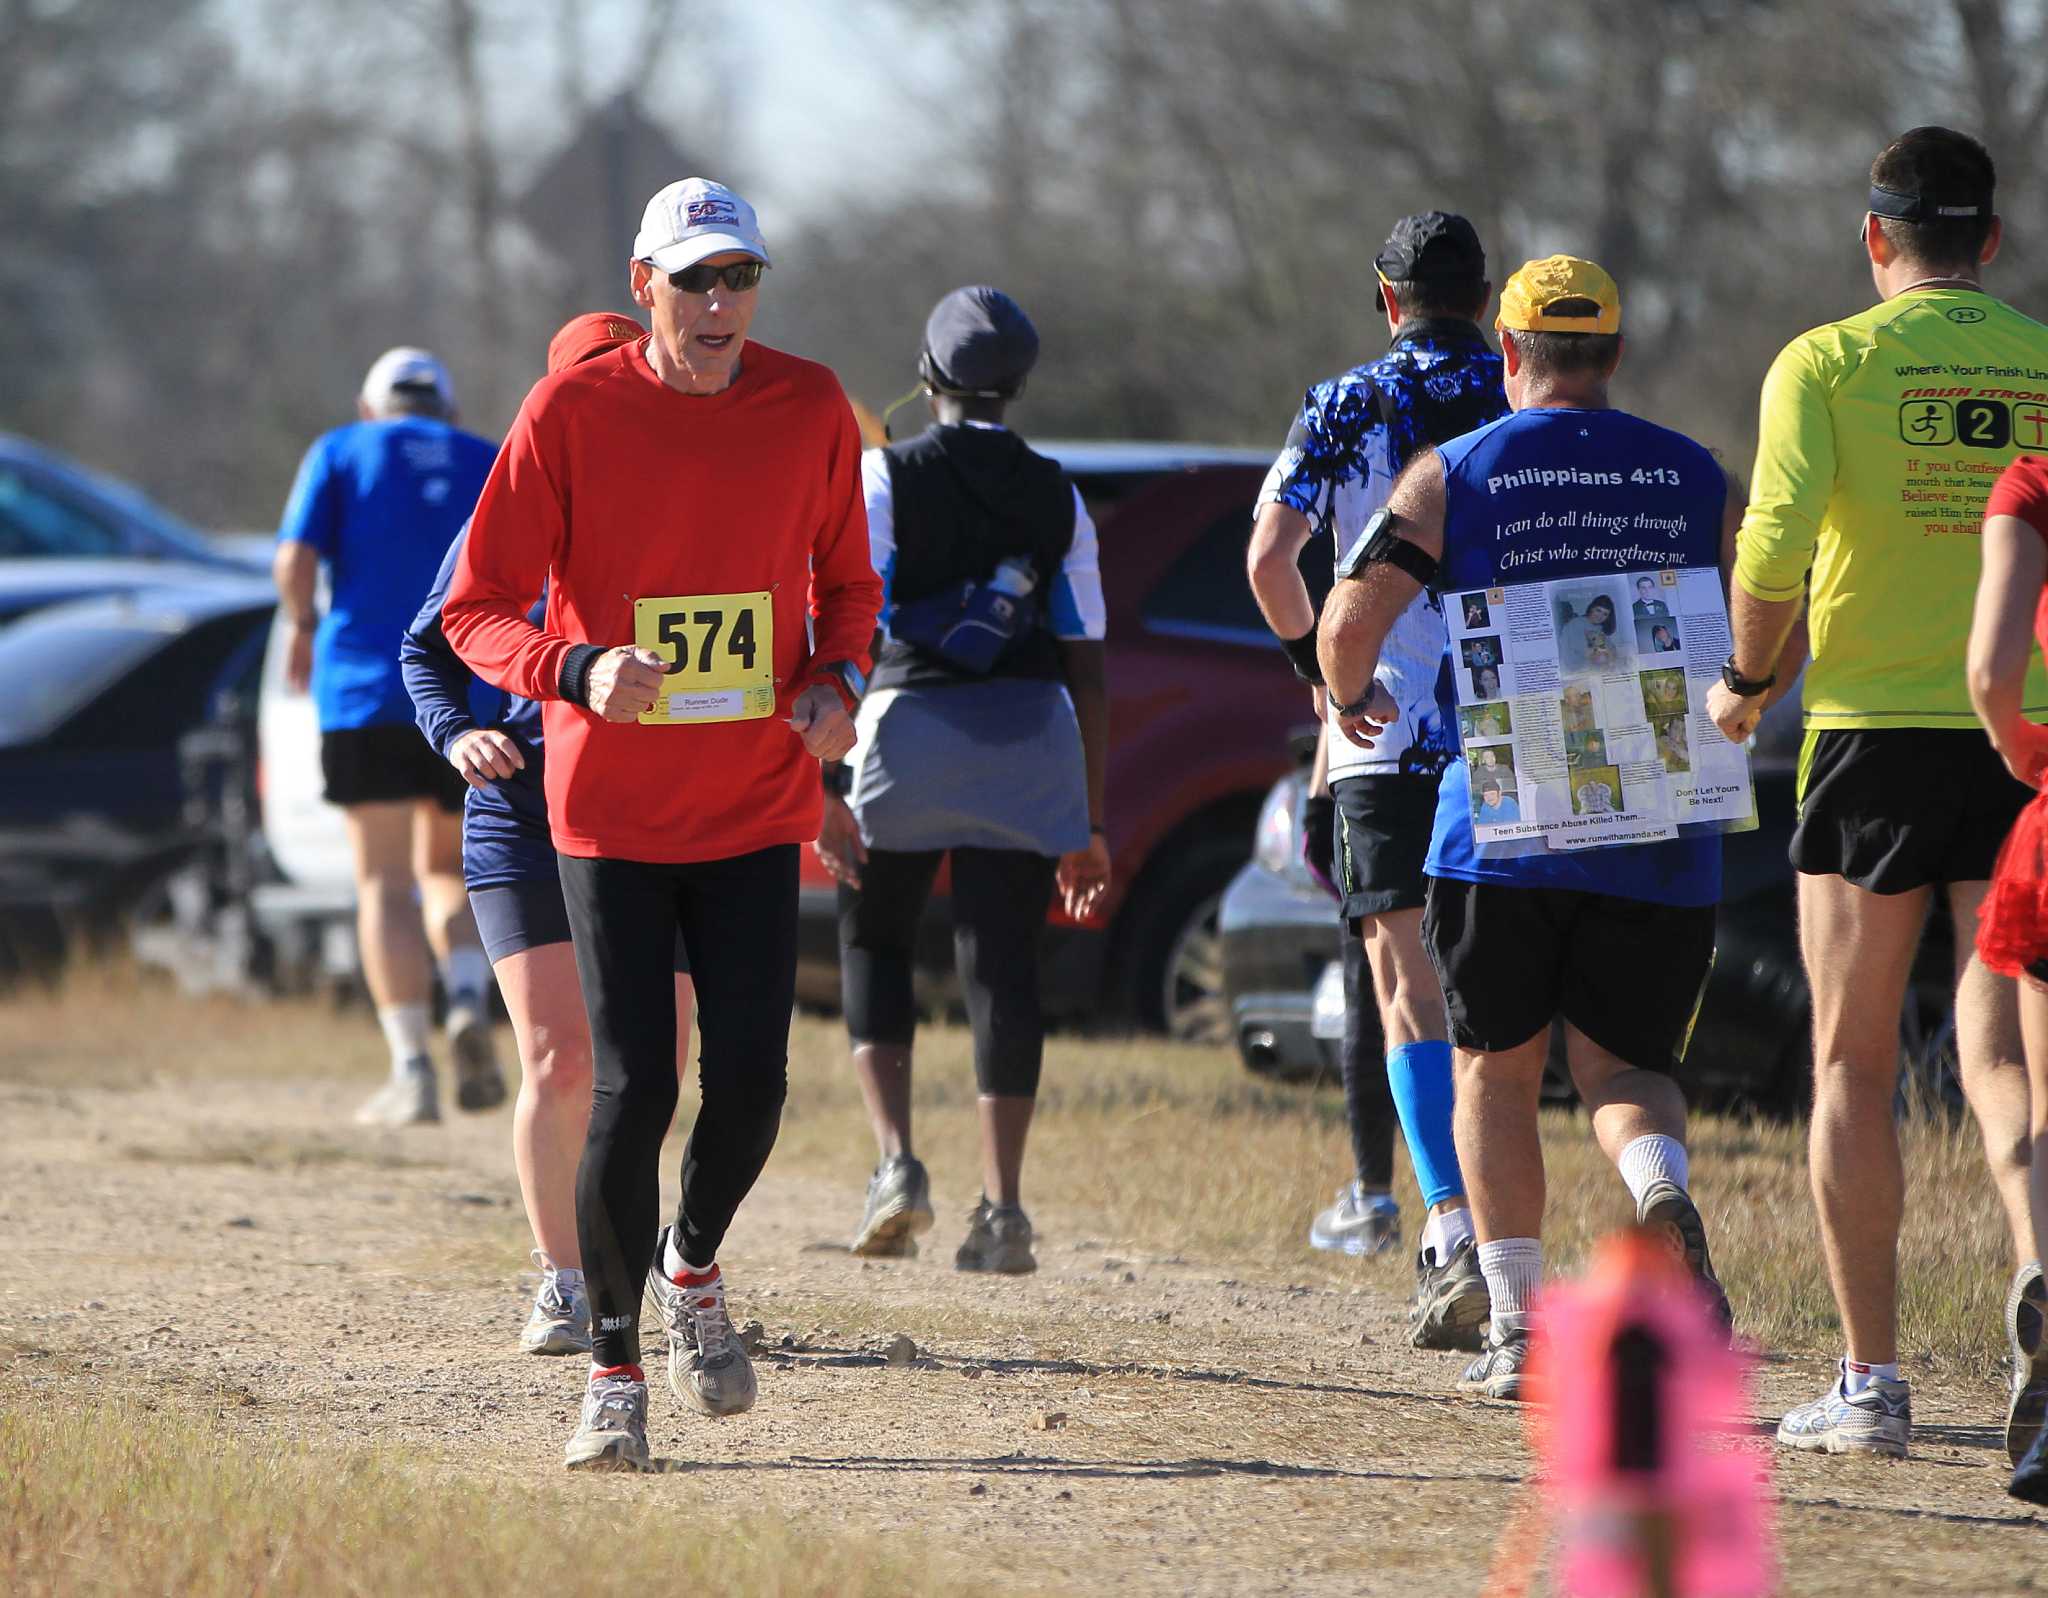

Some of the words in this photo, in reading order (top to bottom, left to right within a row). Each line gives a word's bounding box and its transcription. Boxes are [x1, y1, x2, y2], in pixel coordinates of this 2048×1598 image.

[1950, 365, 1982, 376] Your
[1986, 366, 2023, 377] Finish
[1901, 387, 1973, 399] FINISH
[1976, 389, 2048, 401] STRON
[1970, 407, 1994, 441] 2
[1907, 459, 1921, 472] If
[1926, 462, 1950, 475] you
[1955, 460, 2006, 474] Confess
[1487, 467, 1623, 494] Philippians
[1630, 468, 1680, 486] 4:13
[1906, 478, 1941, 487] mouth
[1944, 478, 1965, 488] that
[1902, 489, 1948, 502] Believe
[1951, 494, 1962, 503] in
[1905, 508, 1937, 518] raised
[1941, 508, 1962, 518] Him
[1496, 524, 1501, 540] I
[1505, 518, 1531, 536] can
[1535, 512, 1554, 529] do
[1558, 511, 1577, 527] all
[1582, 511, 1629, 536] things
[1633, 512, 1687, 538] through
[1923, 523, 1948, 537] you
[1500, 547, 1544, 570] Christ
[1548, 543, 1578, 561] who
[1583, 544, 1666, 568] strengthens
[1668, 550, 1688, 565] me.
[658, 608, 756, 676] 574
[684, 698, 709, 706] Runner
[1676, 788, 1698, 797] Don't
[1700, 787, 1713, 795] Let
[1715, 785, 1740, 793] Yours
[1689, 798, 1700, 806] Be
[1702, 796, 1724, 804] Next!
[1493, 827, 1514, 837] Teen
[1515, 822, 1559, 834] Substance
[1561, 817, 1588, 829] Abuse
[1589, 815, 1613, 825] Killed
[1565, 829, 1667, 845] www.runwithamanda.net
